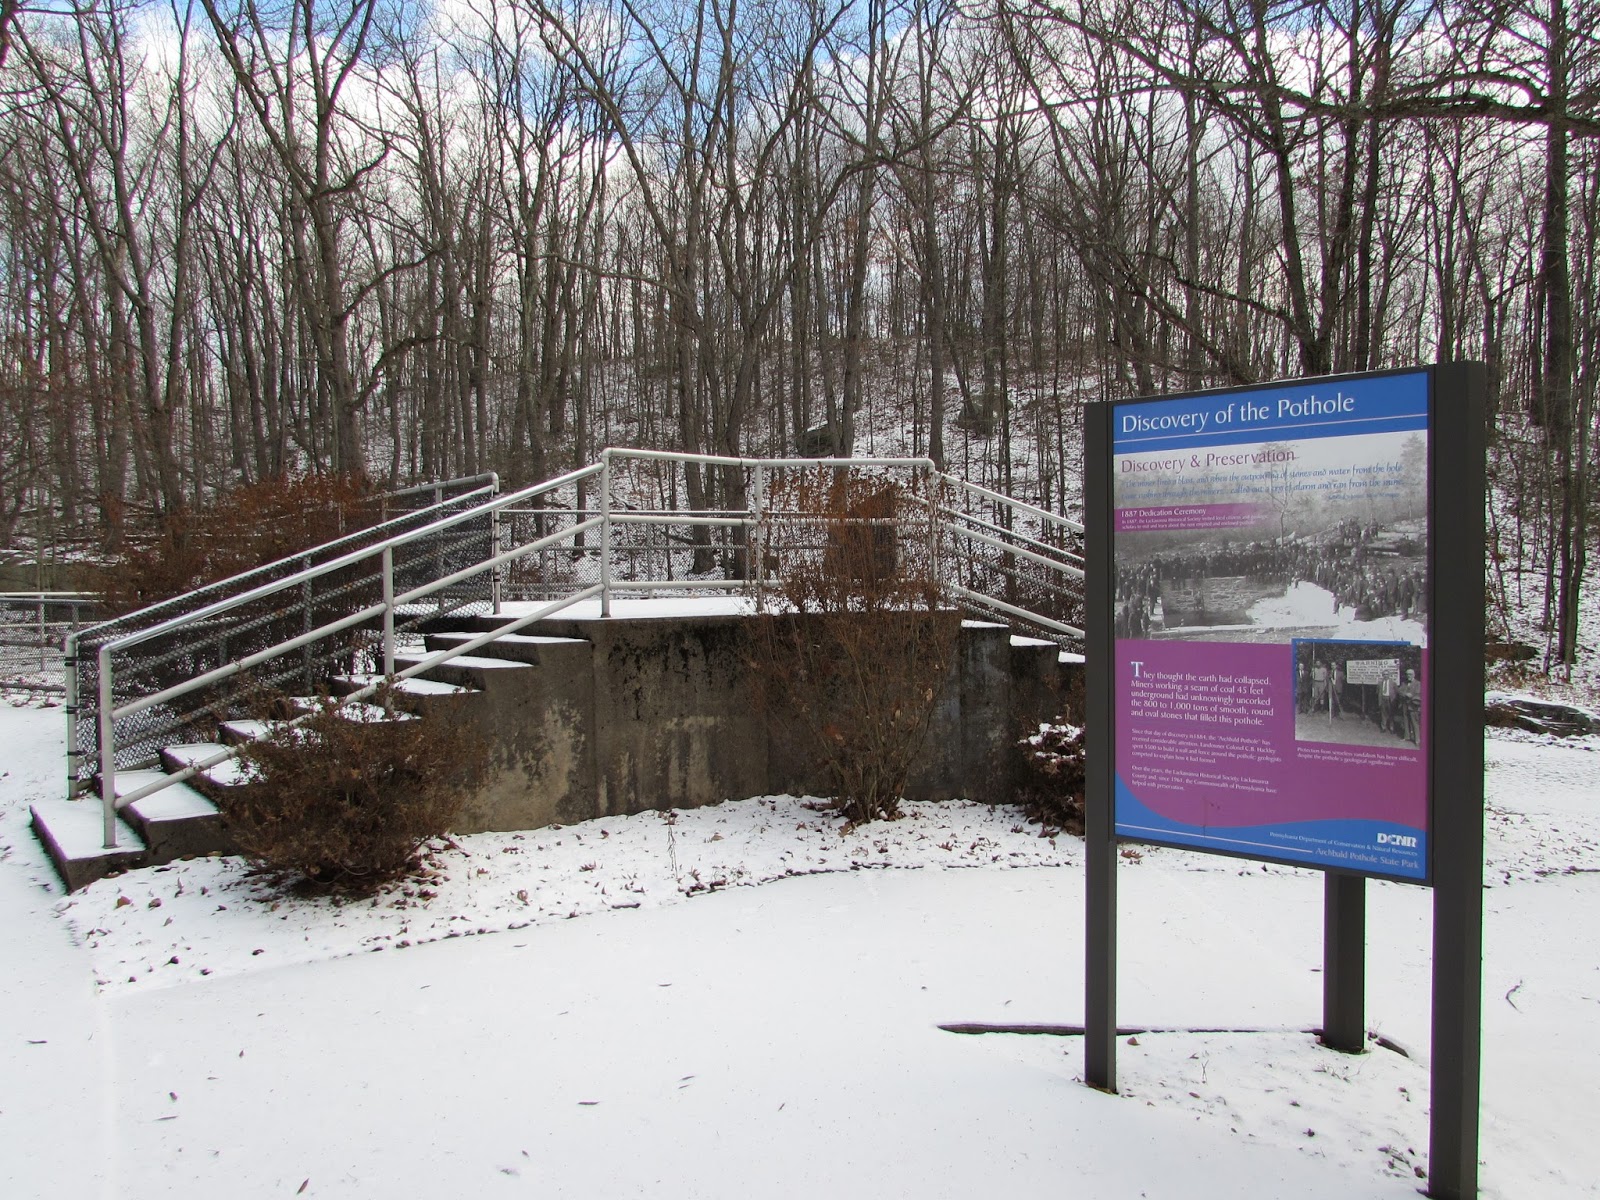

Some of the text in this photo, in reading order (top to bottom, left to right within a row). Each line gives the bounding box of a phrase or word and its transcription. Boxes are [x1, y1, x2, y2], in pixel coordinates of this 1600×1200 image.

[1122, 392, 1355, 433] Discovery of the Pothole
[1122, 450, 1294, 474] Discovery & Preservation
[1329, 468, 1350, 476] water
[1352, 464, 1372, 476] from
[1373, 462, 1384, 474] the
[1293, 481, 1316, 490] alarm
[1318, 481, 1331, 490] and
[1348, 478, 1367, 490] from
[1369, 476, 1381, 486] the
[1174, 508, 1206, 516] Ceremony
[1131, 661, 1271, 688] They thought the earth had collapsed.
[1155, 682, 1182, 692] working
[1210, 683, 1218, 692] of
[1220, 683, 1235, 693] coal
[1250, 684, 1264, 695] feet
[1131, 690, 1270, 705] underground had unknowingly uncorked
[1170, 702, 1191, 711] 1,000
[1210, 703, 1218, 712] of
[1220, 704, 1249, 715] smooth,
[1251, 707, 1274, 716] round
[1160, 712, 1182, 720] stones
[1184, 712, 1198, 720] that
[1200, 713, 1217, 722] filled
[1219, 715, 1232, 723] this
[1234, 716, 1265, 726] pothole.
[1270, 831, 1298, 841] Pennsylvania
[1299, 835, 1326, 845] Department
[1334, 840, 1365, 849] Conservation
[1392, 848, 1418, 856] Resources
[1377, 832, 1417, 848] DCNR
[1315, 848, 1419, 868] Archbald Pothole State Park
